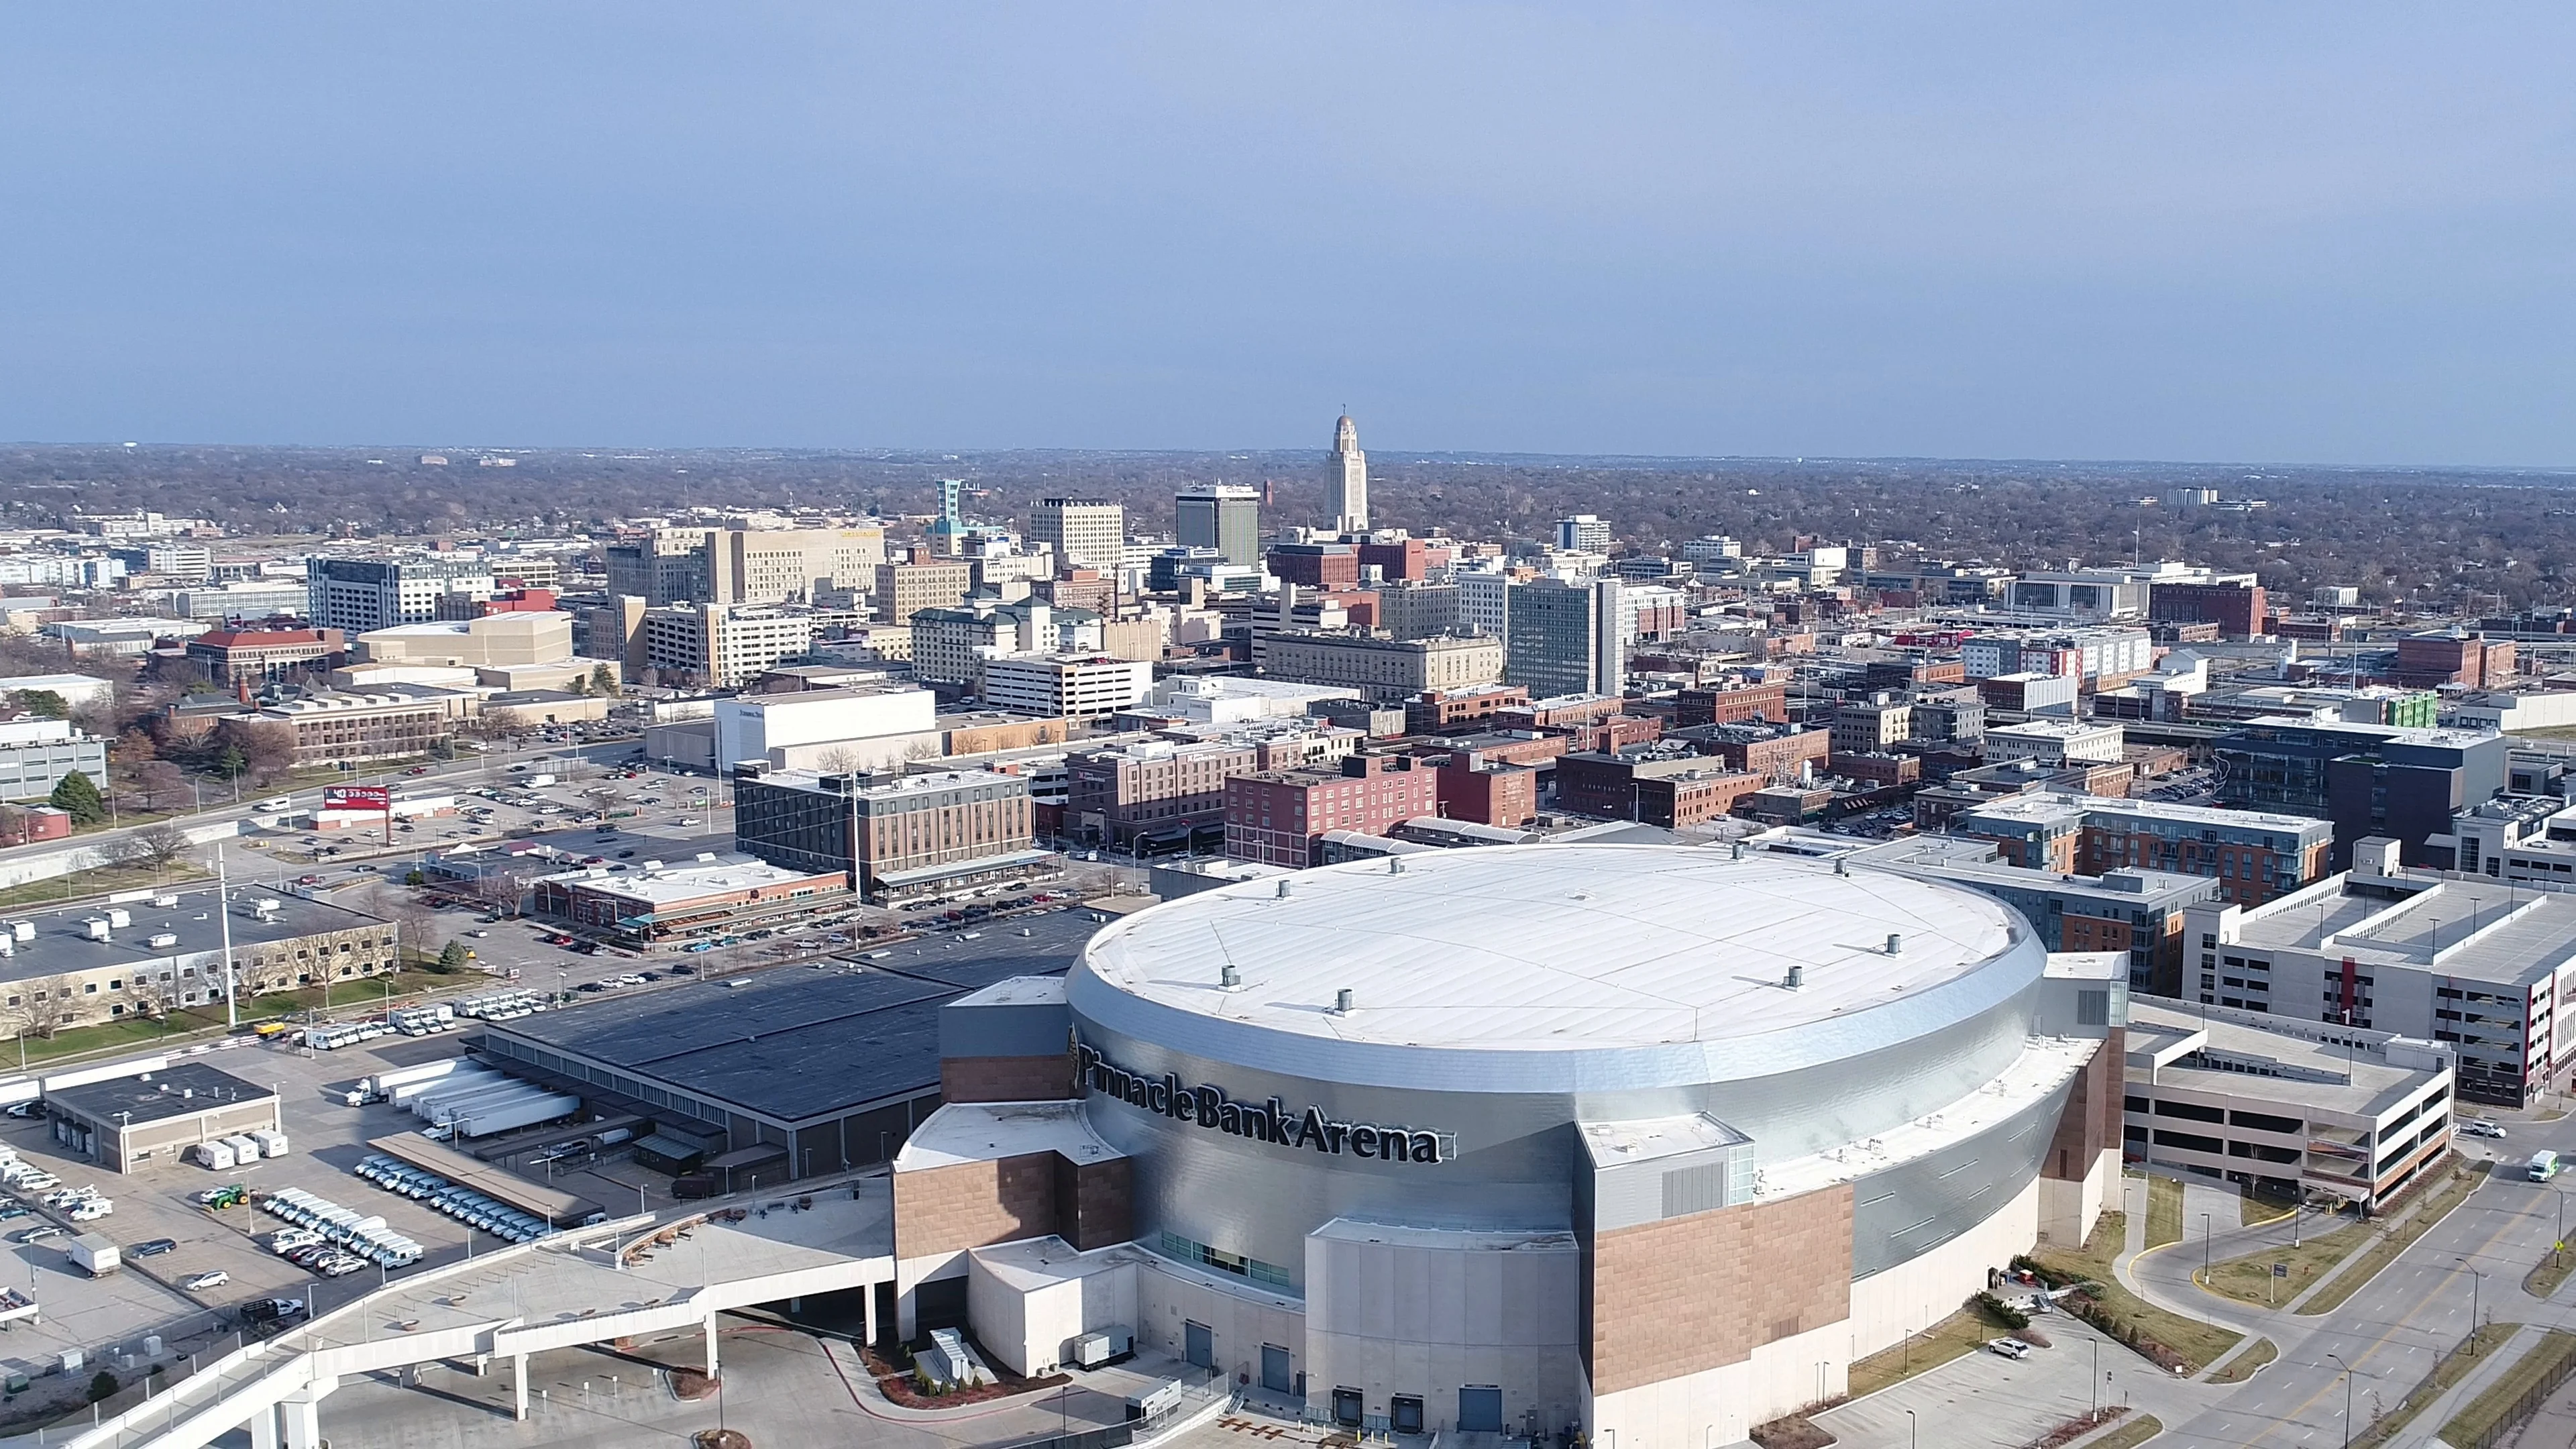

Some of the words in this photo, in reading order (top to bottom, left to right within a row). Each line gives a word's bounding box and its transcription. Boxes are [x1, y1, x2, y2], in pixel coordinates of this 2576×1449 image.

[2341, 1008, 2351, 1025] 1
[1079, 1044, 1193, 1121] Pinnacle
[1196, 1083, 1293, 1148] Bank
[1295, 1104, 1442, 1165] Arena
